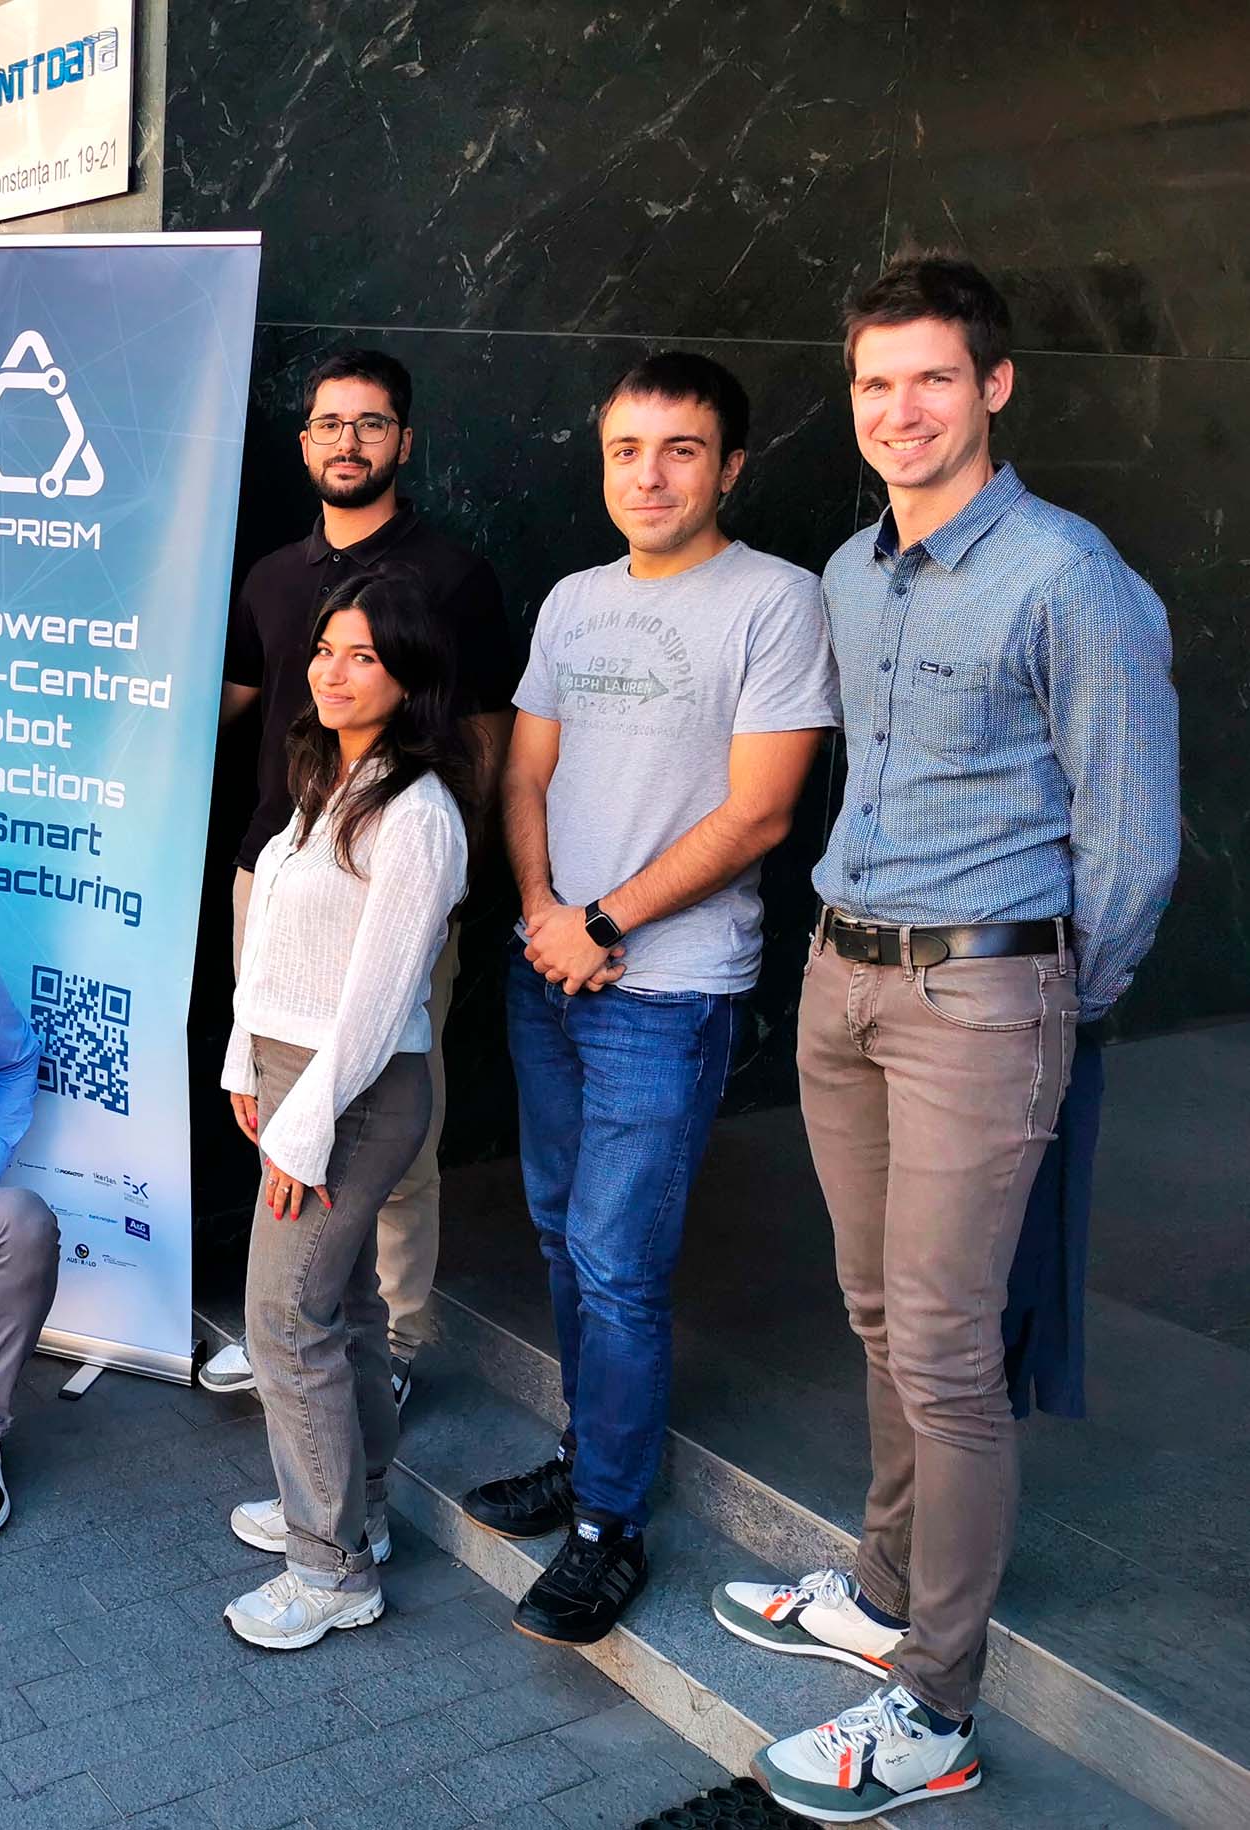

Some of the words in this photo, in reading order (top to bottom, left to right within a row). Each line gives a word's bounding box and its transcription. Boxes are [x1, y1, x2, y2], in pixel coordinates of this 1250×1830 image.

[54, 160, 71, 179] nr.
[77, 138, 118, 174] 19-21
[564, 610, 622, 648] DENIM
[625, 611, 663, 634] AND
[587, 655, 633, 675] 1967
